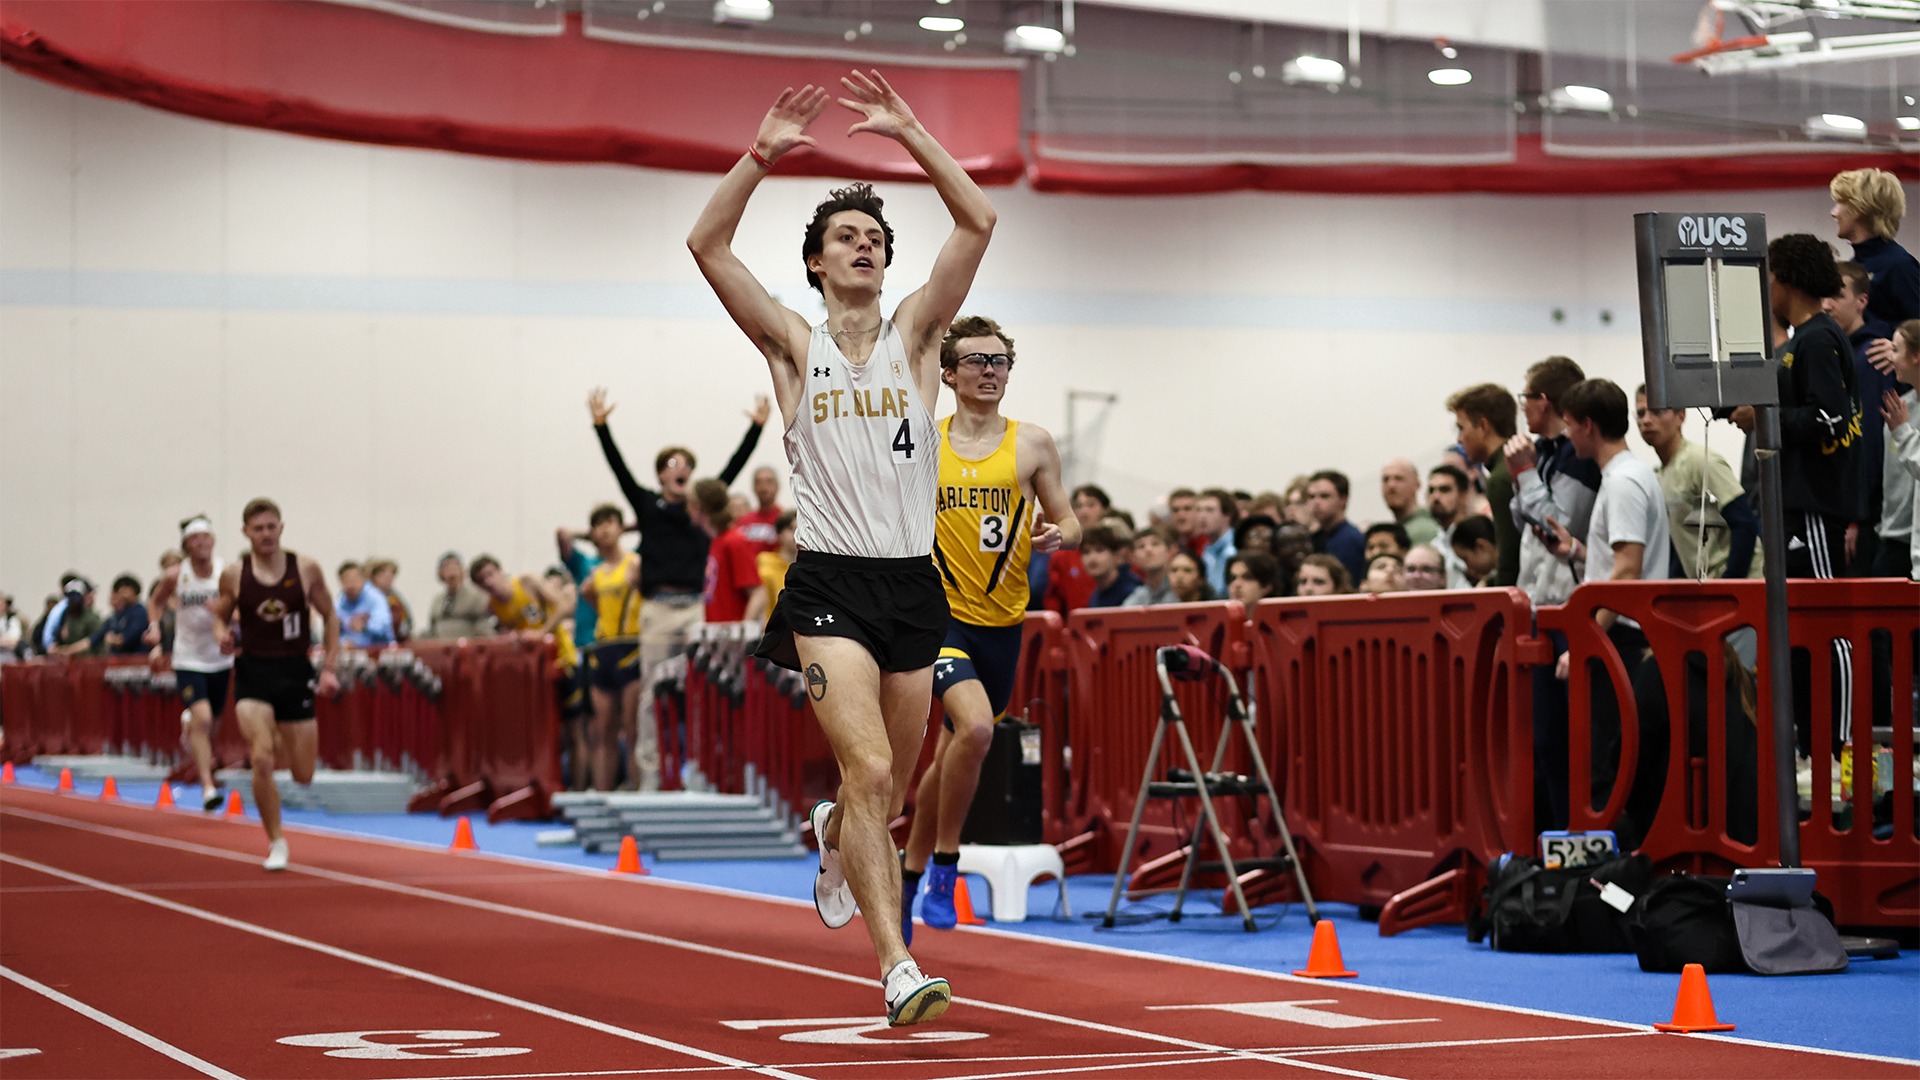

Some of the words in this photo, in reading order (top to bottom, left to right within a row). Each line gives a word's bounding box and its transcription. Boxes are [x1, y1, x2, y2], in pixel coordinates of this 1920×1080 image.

[1697, 216, 1747, 246] UCS
[813, 389, 848, 424] ST.
[853, 387, 909, 418] OLAF
[892, 418, 915, 459] 4
[936, 486, 1011, 517] ARLETON
[982, 515, 1004, 549] 3
[275, 1029, 533, 1060] 3
[718, 1016, 990, 1044] 2
